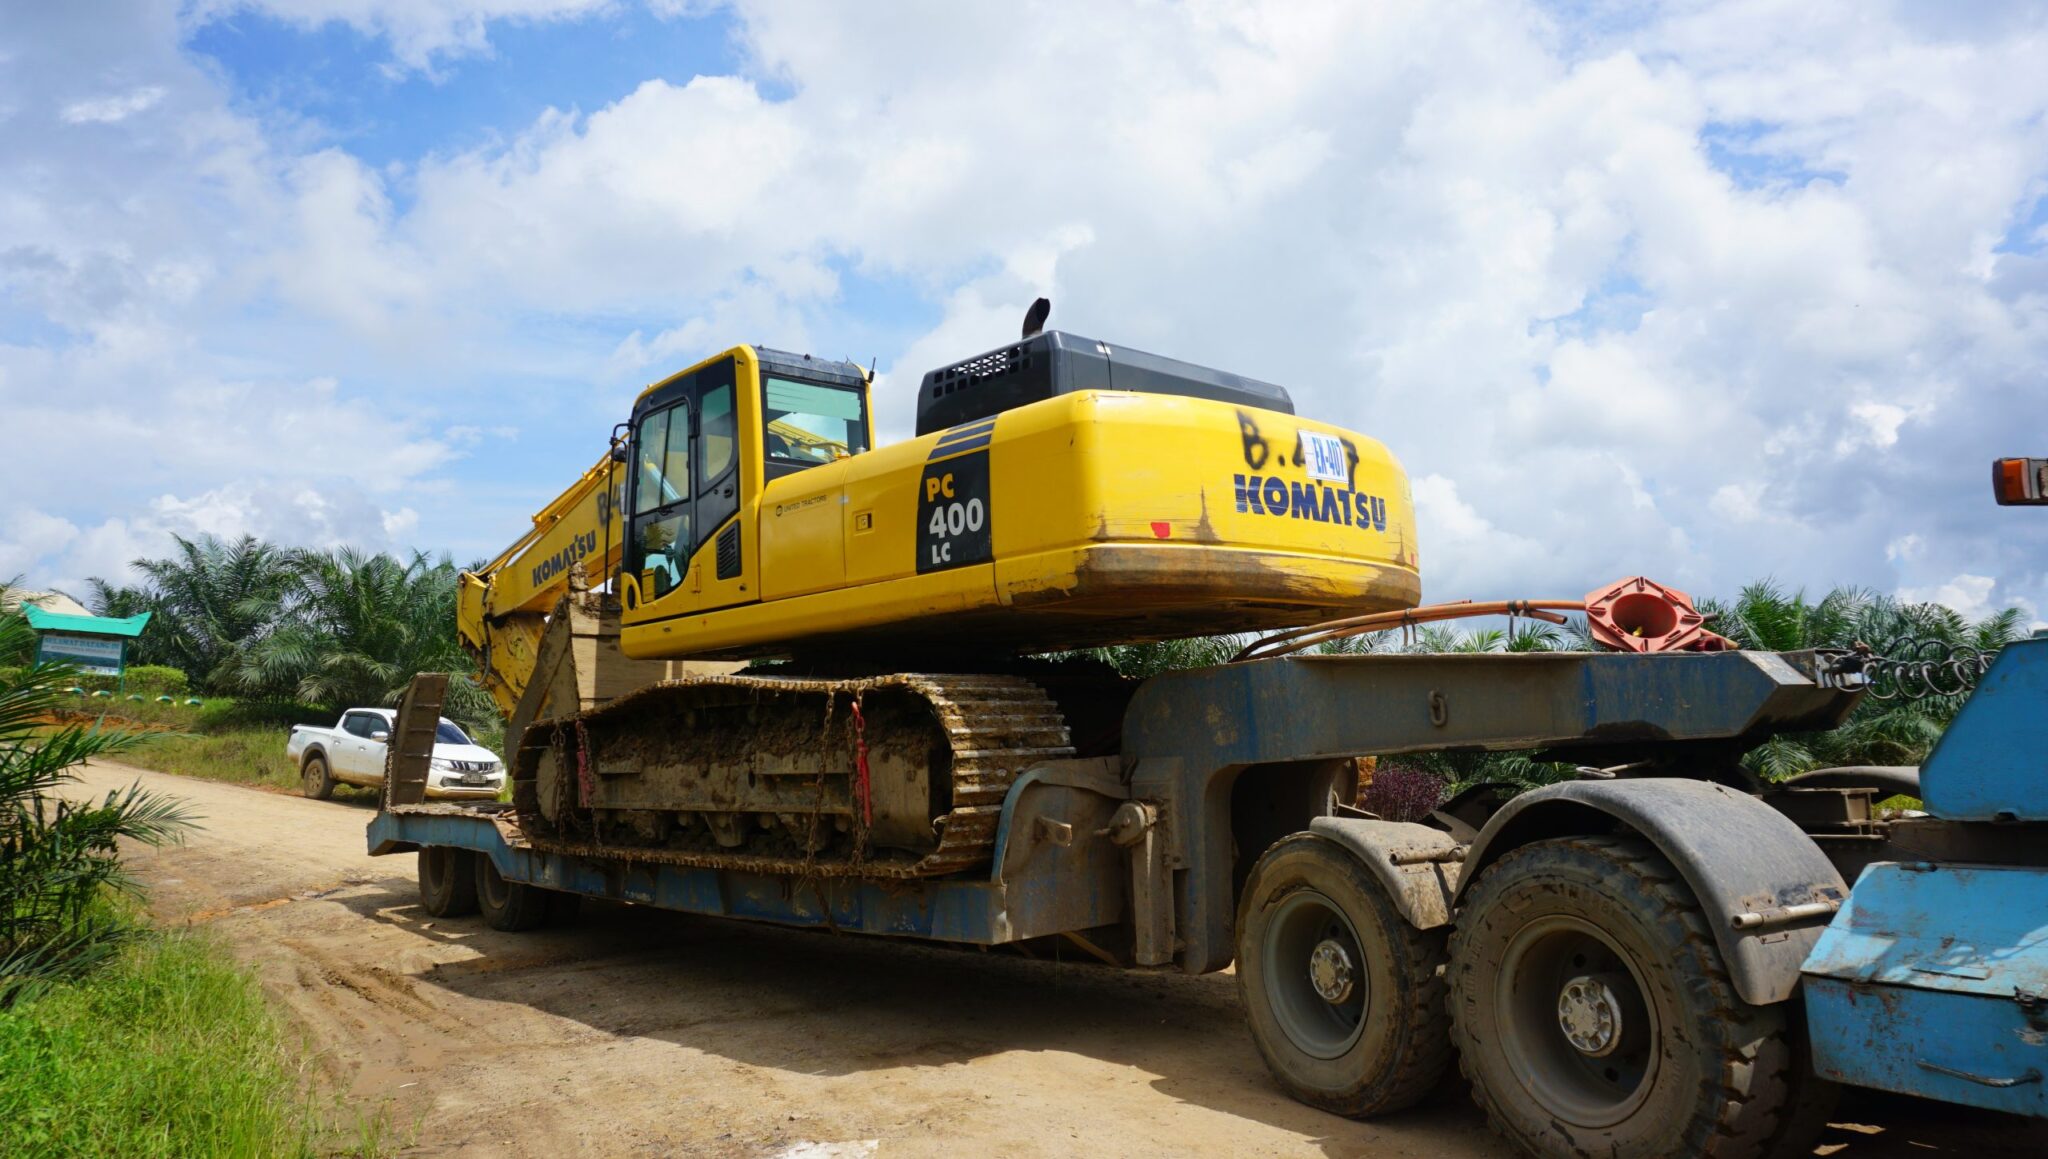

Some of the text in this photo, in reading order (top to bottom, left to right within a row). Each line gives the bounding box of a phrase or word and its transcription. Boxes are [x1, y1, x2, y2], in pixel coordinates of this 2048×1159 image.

[801, 494, 827, 505] TRACTORS
[926, 473, 955, 502] PC
[1233, 473, 1387, 533] KOMATSU
[929, 498, 984, 539] 400
[532, 530, 597, 588] KOMATSU
[931, 542, 951, 564] LC
